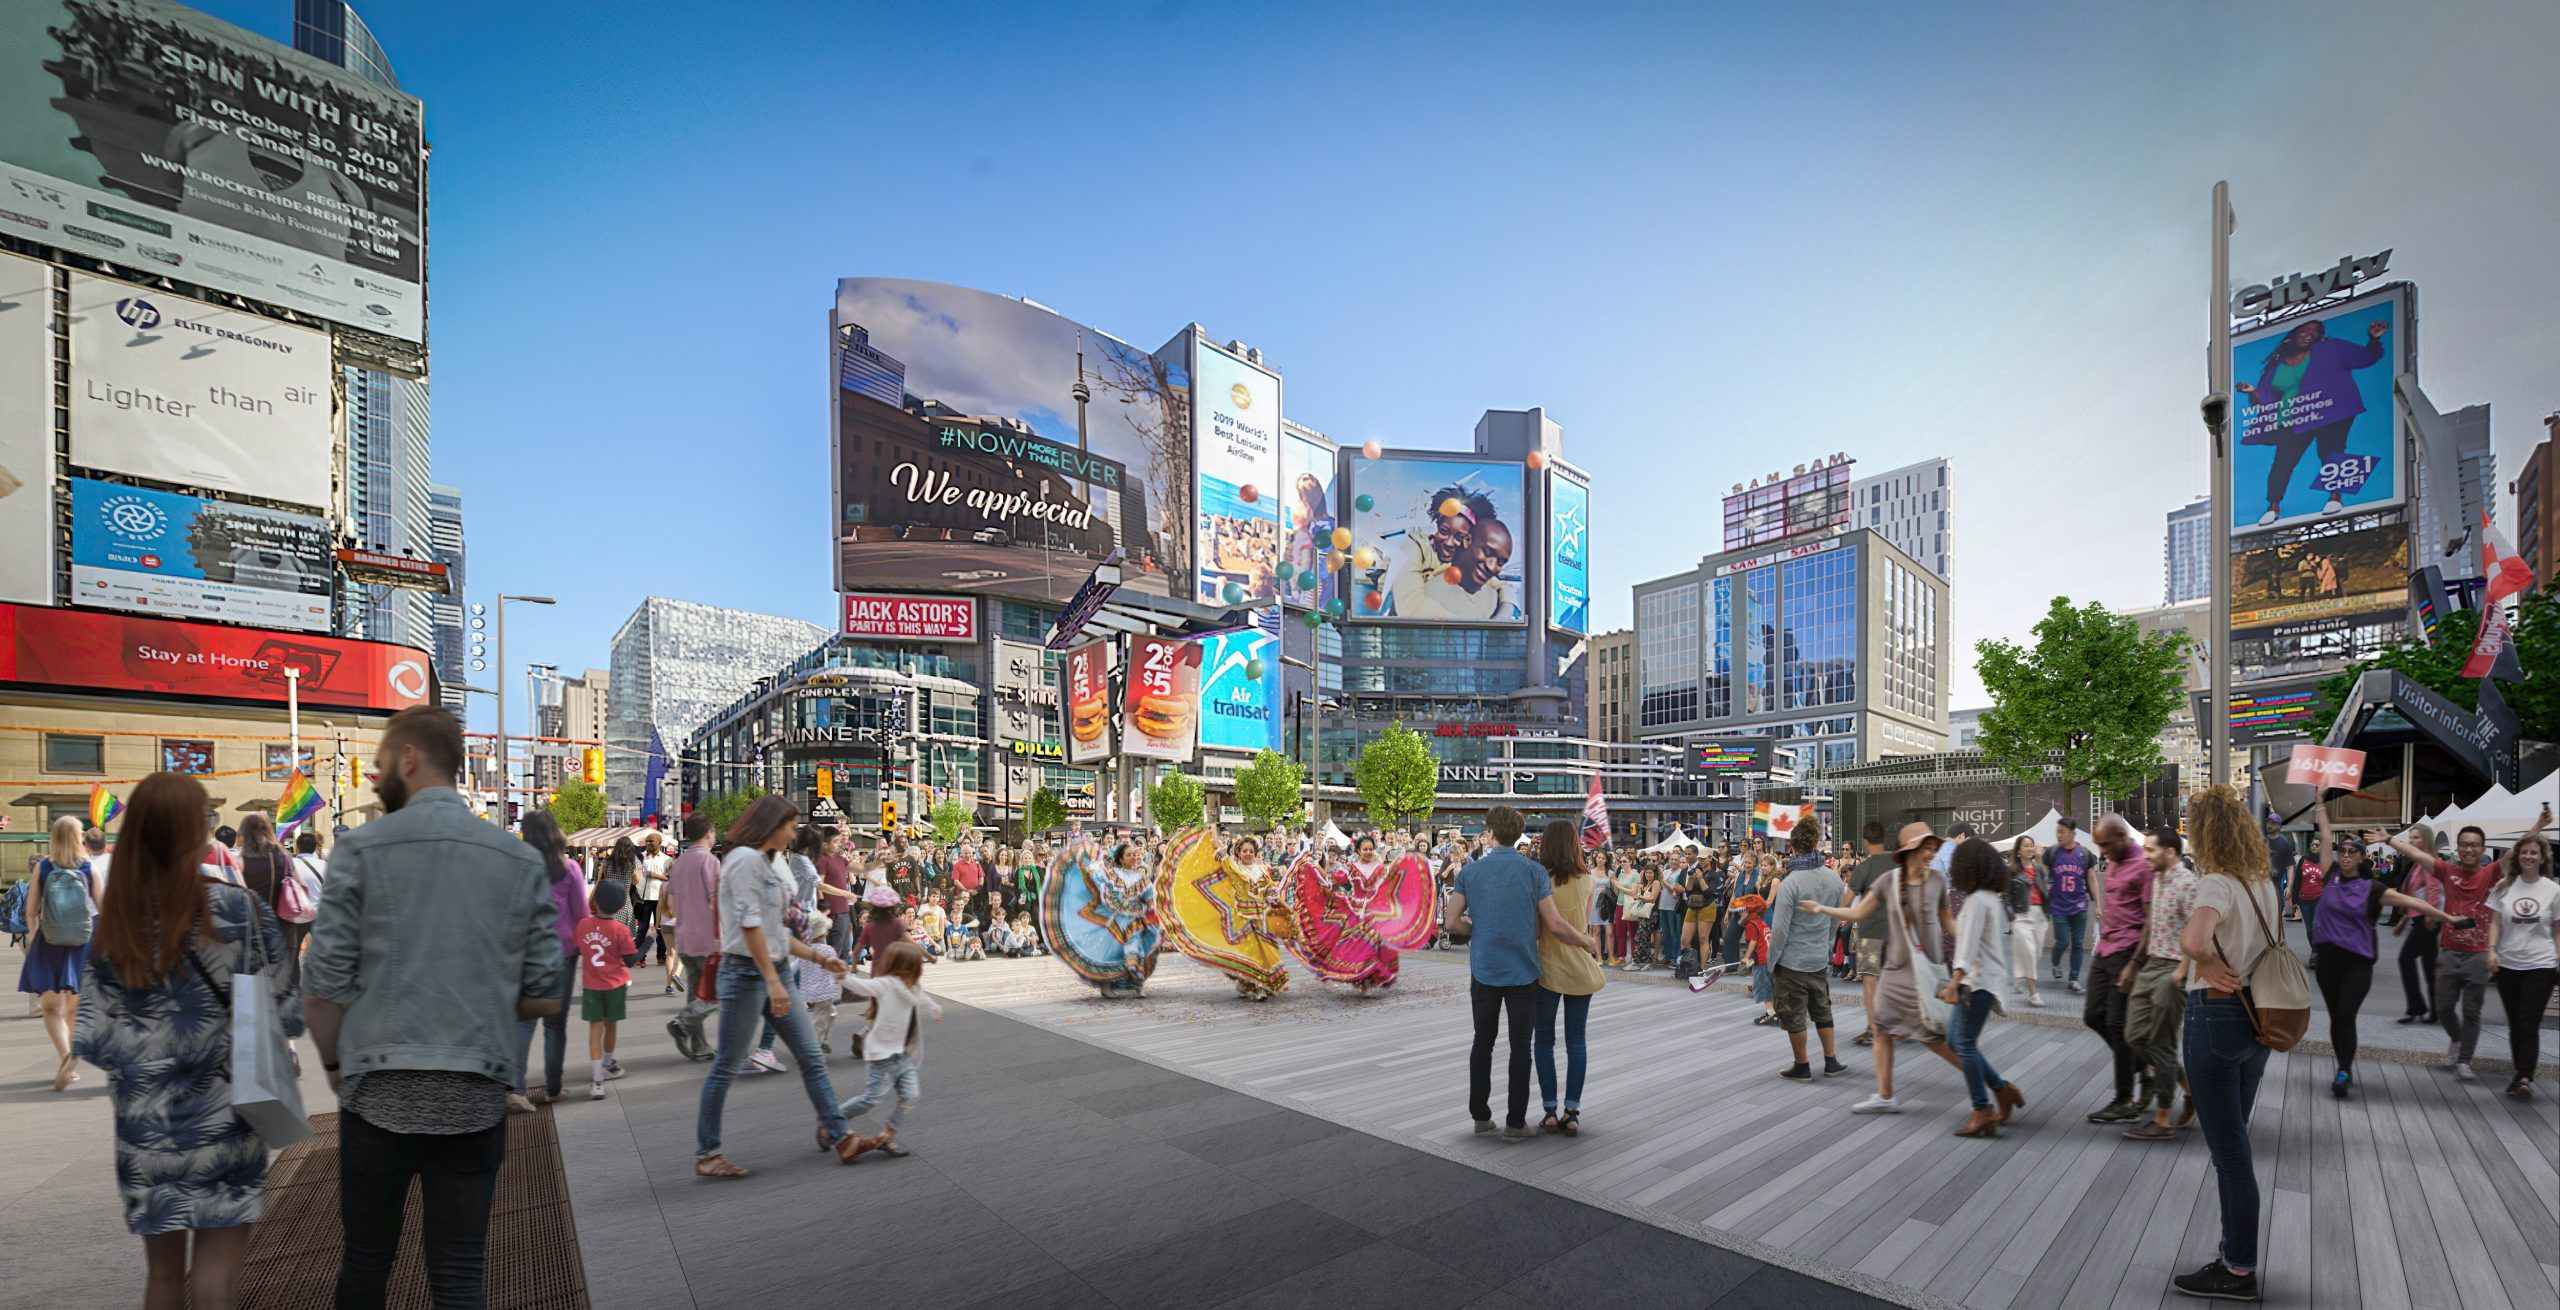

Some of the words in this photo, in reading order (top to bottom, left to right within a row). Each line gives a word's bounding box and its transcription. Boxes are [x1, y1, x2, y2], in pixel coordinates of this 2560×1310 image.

[160, 44, 245, 91] SPIN
[253, 76, 341, 125] WITH
[351, 112, 399, 146] US!
[175, 103, 229, 136] First
[235, 127, 339, 171] Canadian
[344, 162, 400, 192] Place
[210, 99, 303, 141] October
[348, 147, 399, 175] 2019
[306, 190, 378, 225] REGISTER
[382, 216, 400, 229] AT
[122, 298, 160, 330] hp
[174, 318, 212, 336] ELITE
[216, 328, 293, 355] DRAGONFLY
[87, 378, 197, 418] Lighter
[209, 385, 273, 416] than
[284, 385, 318, 406] air
[2241, 401, 2284, 417] When
[2287, 390, 2322, 408] your
[1213, 410, 1234, 427] 2019
[1236, 419, 1268, 441] World's
[2242, 412, 2279, 428] song
[2281, 398, 2334, 418] comes
[2242, 427, 2261, 438] on
[2263, 421, 2279, 433] at
[2281, 411, 2324, 428] work.
[1214, 425, 1234, 441] Best
[940, 427, 1027, 458] #NOW
[1061, 451, 1118, 486] EVER
[1027, 441, 1059, 458] MORE
[1028, 451, 1059, 467] THAN
[1793, 451, 1846, 478] SAM
[2319, 456, 2371, 482] 98.1
[889, 461, 964, 506] We
[1732, 471, 1780, 496] SAM
[225, 519, 258, 532] SPIN
[260, 524, 296, 538] WITH
[1791, 542, 1821, 557] SAM
[1729, 558, 1758, 571] SAM
[849, 600, 893, 621] JACK
[897, 602, 969, 624] ASTOR'S
[849, 620, 884, 632] PARTY
[885, 620, 896, 632] IS
[897, 621, 922, 634] THIS
[923, 622, 947, 635] WAY
[2273, 619, 2349, 636] Panasonic
[138, 645, 181, 665] Stay
[186, 652, 205, 664] at
[210, 652, 270, 670] Home
[1073, 653, 1085, 681] 2
[1144, 643, 1164, 671] 2
[1163, 645, 1174, 672] FOR
[799, 687, 860, 698] CINEPLEX
[1074, 679, 1091, 703] $5
[1143, 671, 1172, 696] $5
[1230, 684, 1252, 702] Air
[1213, 698, 1271, 722] transat
[2398, 680, 2438, 718] Visitor
[1952, 809, 2005, 822] NIGHT
[2062, 876, 2076, 892] 15
[2309, 875, 2316, 883] 2
[590, 944, 606, 967] 2
